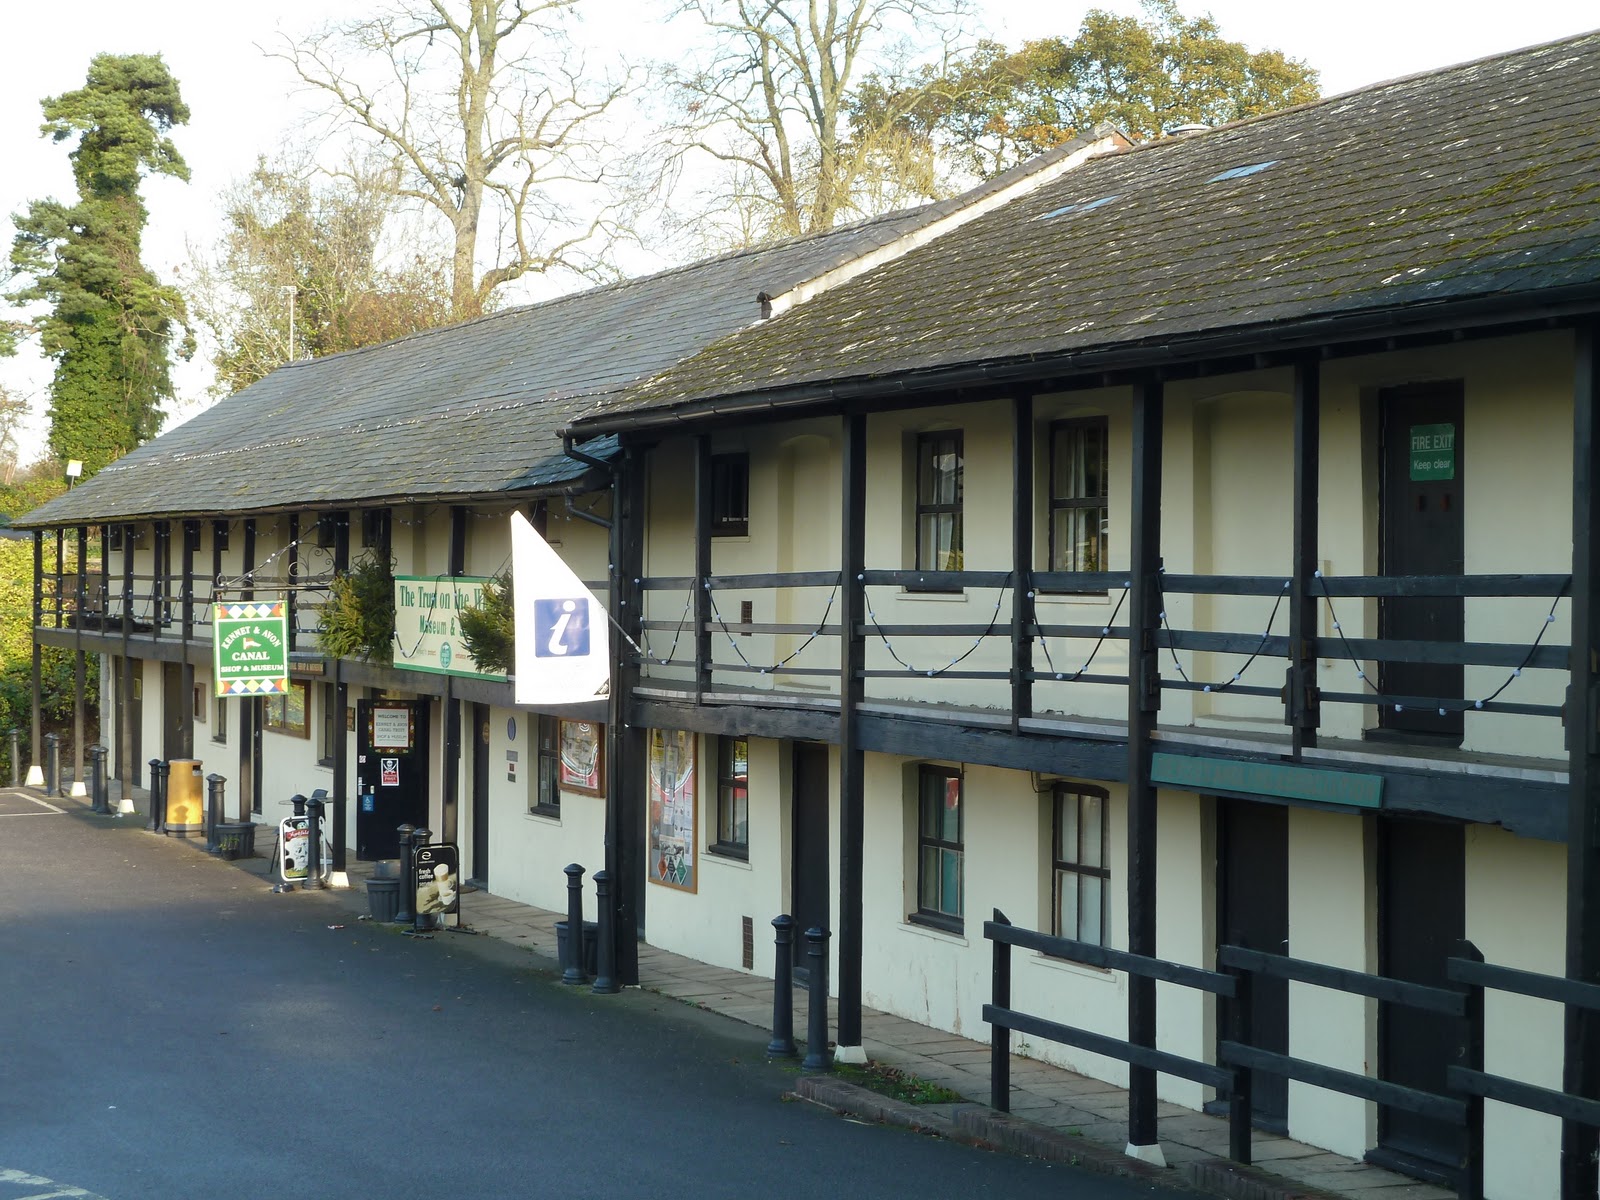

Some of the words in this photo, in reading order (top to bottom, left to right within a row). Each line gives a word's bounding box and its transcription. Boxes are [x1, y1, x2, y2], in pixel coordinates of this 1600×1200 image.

[1412, 436, 1431, 450] FIRE
[1434, 434, 1453, 449] EXIT
[1413, 460, 1431, 471] Keep
[1433, 459, 1451, 469] clear
[400, 585, 415, 607] The
[418, 586, 438, 609] Trut
[440, 593, 451, 610] on
[450, 617, 455, 637] &
[221, 625, 251, 650] KENNET
[253, 626, 260, 635] &
[262, 630, 281, 647] AVON
[232, 652, 270, 661] CANAL
